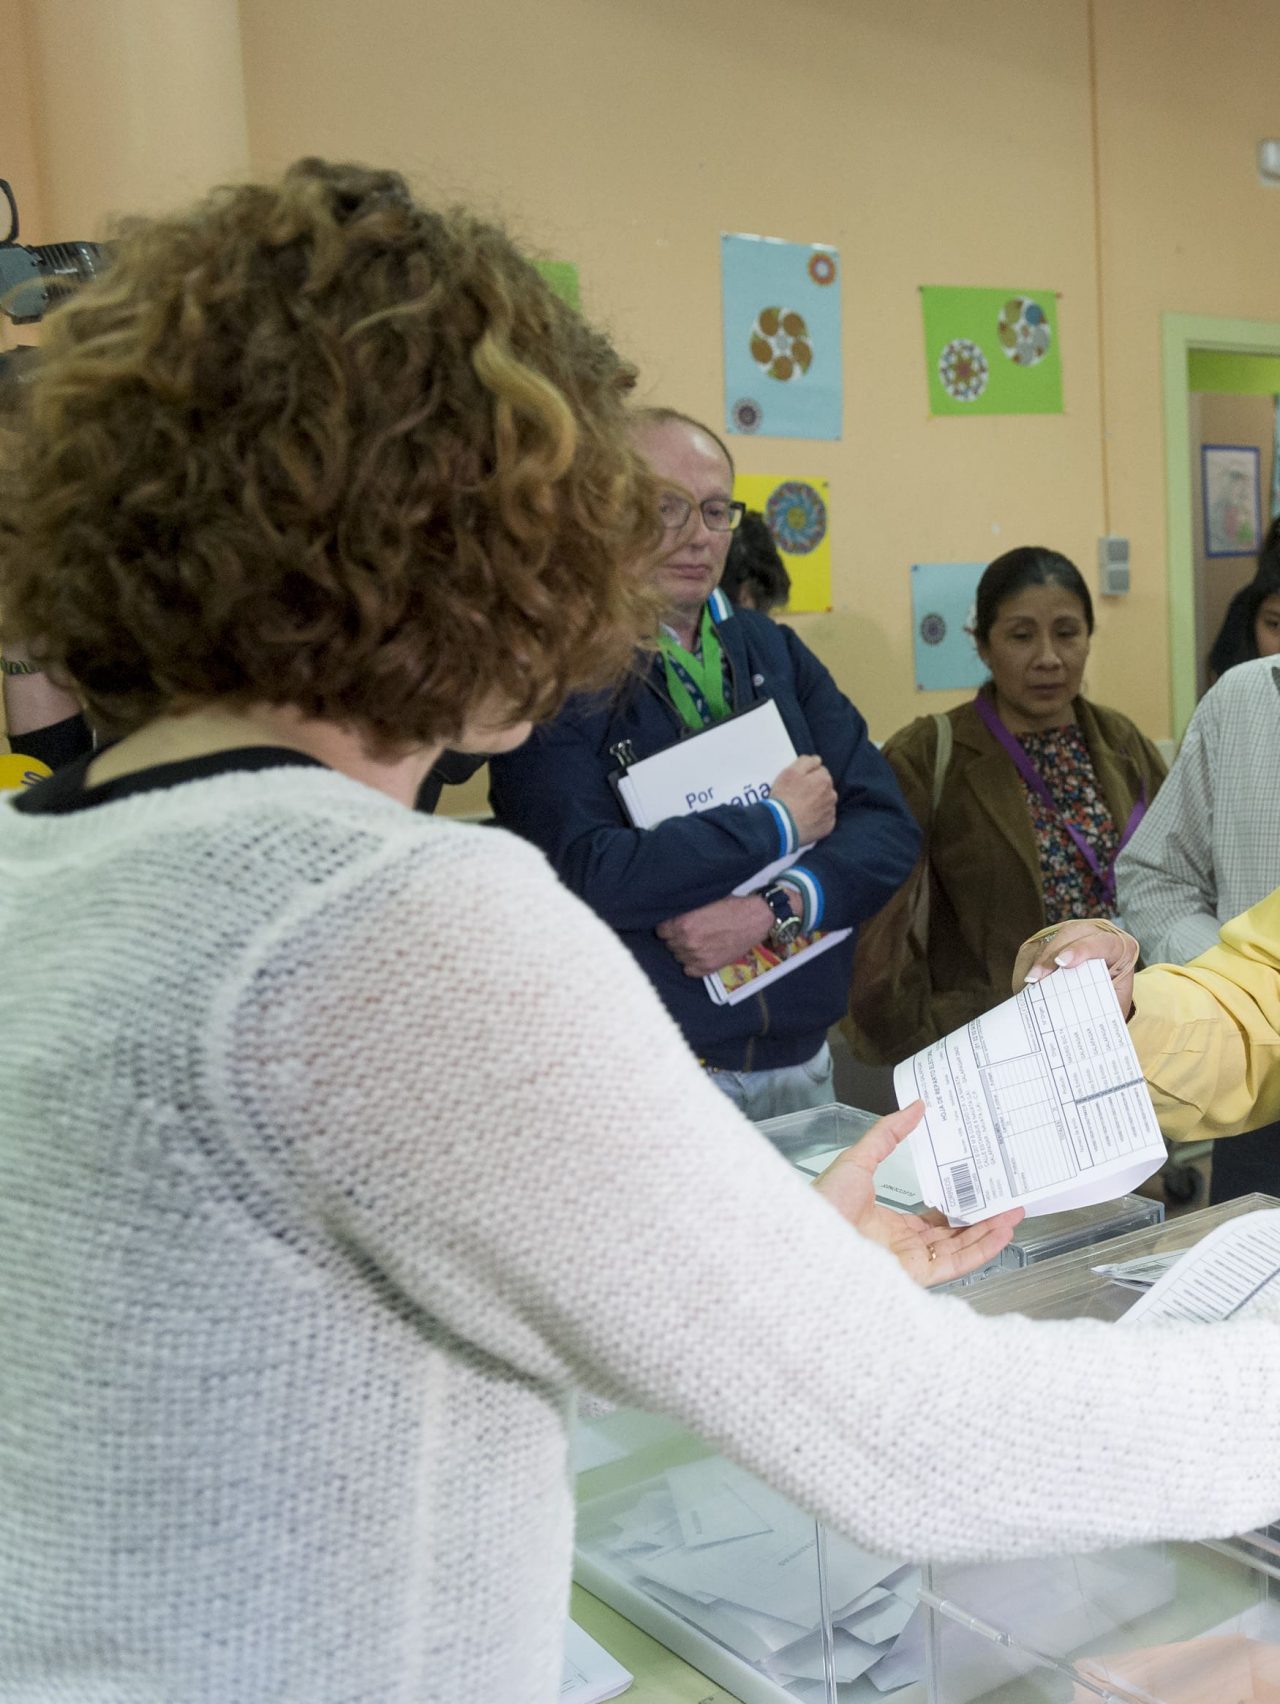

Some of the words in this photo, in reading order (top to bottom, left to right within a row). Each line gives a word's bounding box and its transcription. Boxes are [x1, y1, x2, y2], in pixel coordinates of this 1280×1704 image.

[685, 786, 714, 809] Por
[730, 782, 771, 807] aña
[928, 1068, 942, 1095] REPARTO
[935, 1094, 944, 1104] DE
[937, 1103, 948, 1122] HOJA
[943, 1175, 957, 1207] CORREOS
